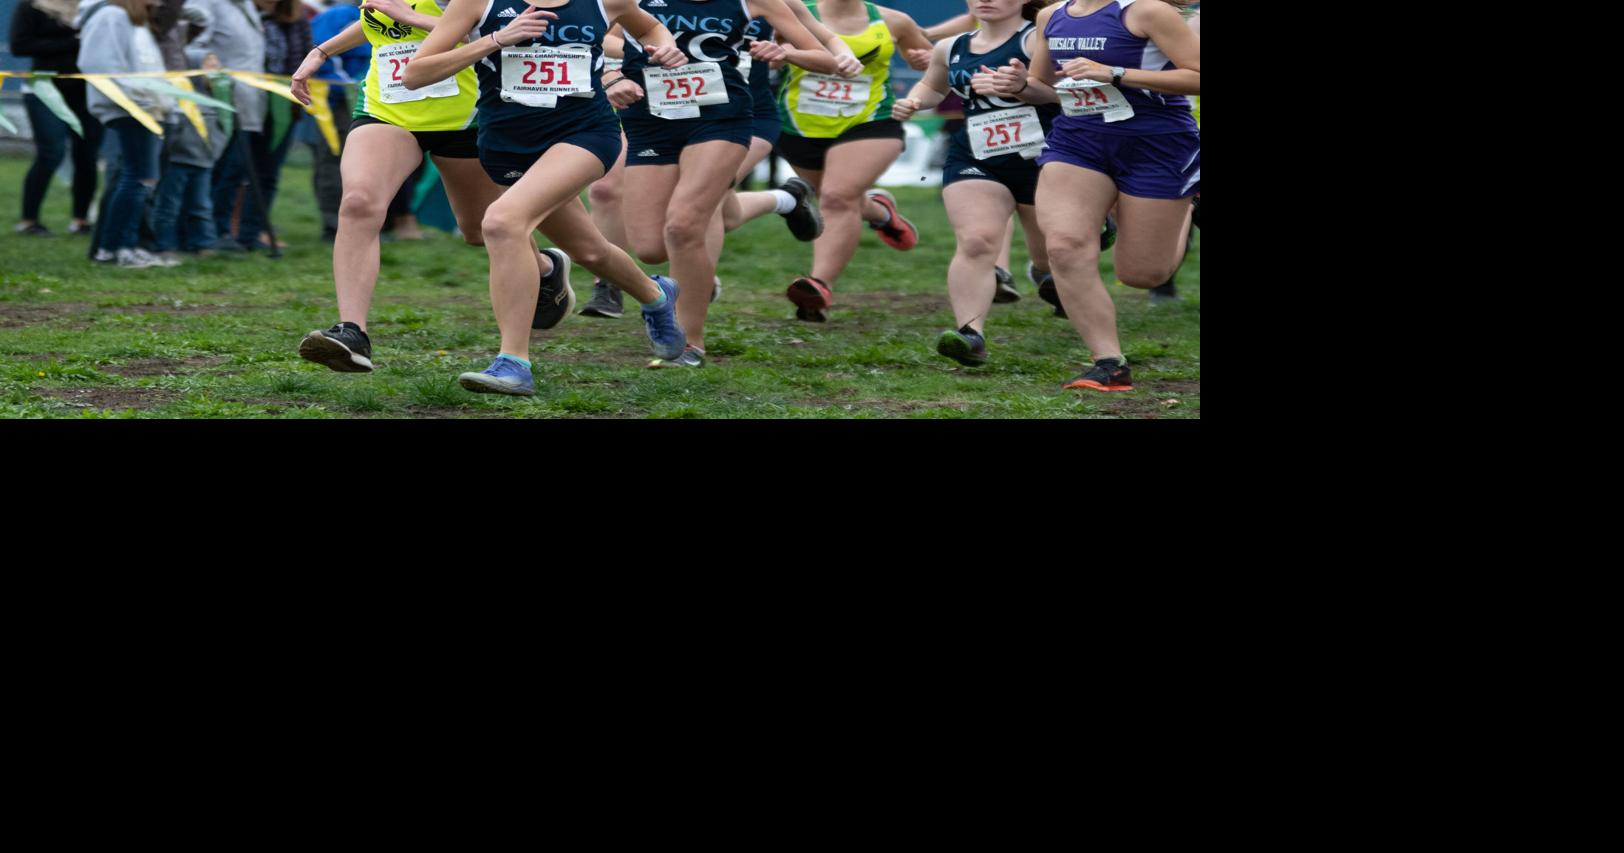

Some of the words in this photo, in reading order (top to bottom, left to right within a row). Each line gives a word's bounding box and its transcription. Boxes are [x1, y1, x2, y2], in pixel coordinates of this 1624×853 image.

[1078, 37, 1107, 50] VALLEY
[522, 60, 572, 85] 251
[662, 76, 708, 99] 252
[815, 80, 852, 101] 221
[982, 121, 1023, 148] 257
